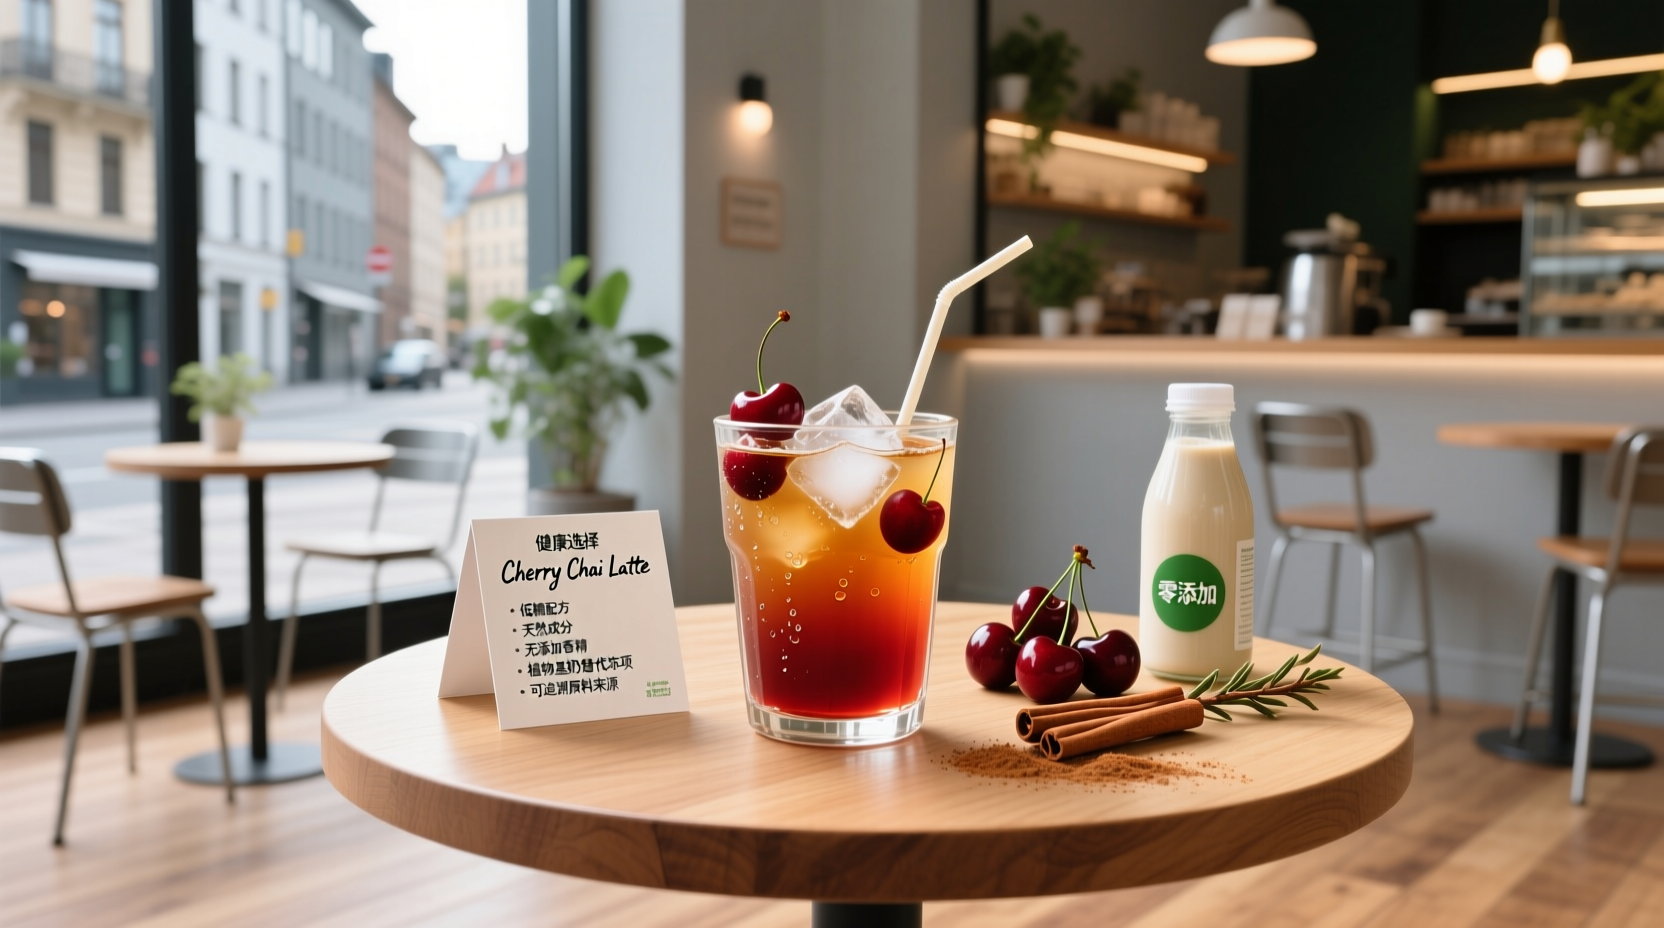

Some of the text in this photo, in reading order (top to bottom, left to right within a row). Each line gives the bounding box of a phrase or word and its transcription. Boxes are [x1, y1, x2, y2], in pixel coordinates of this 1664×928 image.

[535, 532, 600, 552] 健康选择
[501, 554, 651, 591] Cherry Chai Latte
[1158, 580, 1217, 605] 零添加
[522, 620, 573, 637] 天然成分
